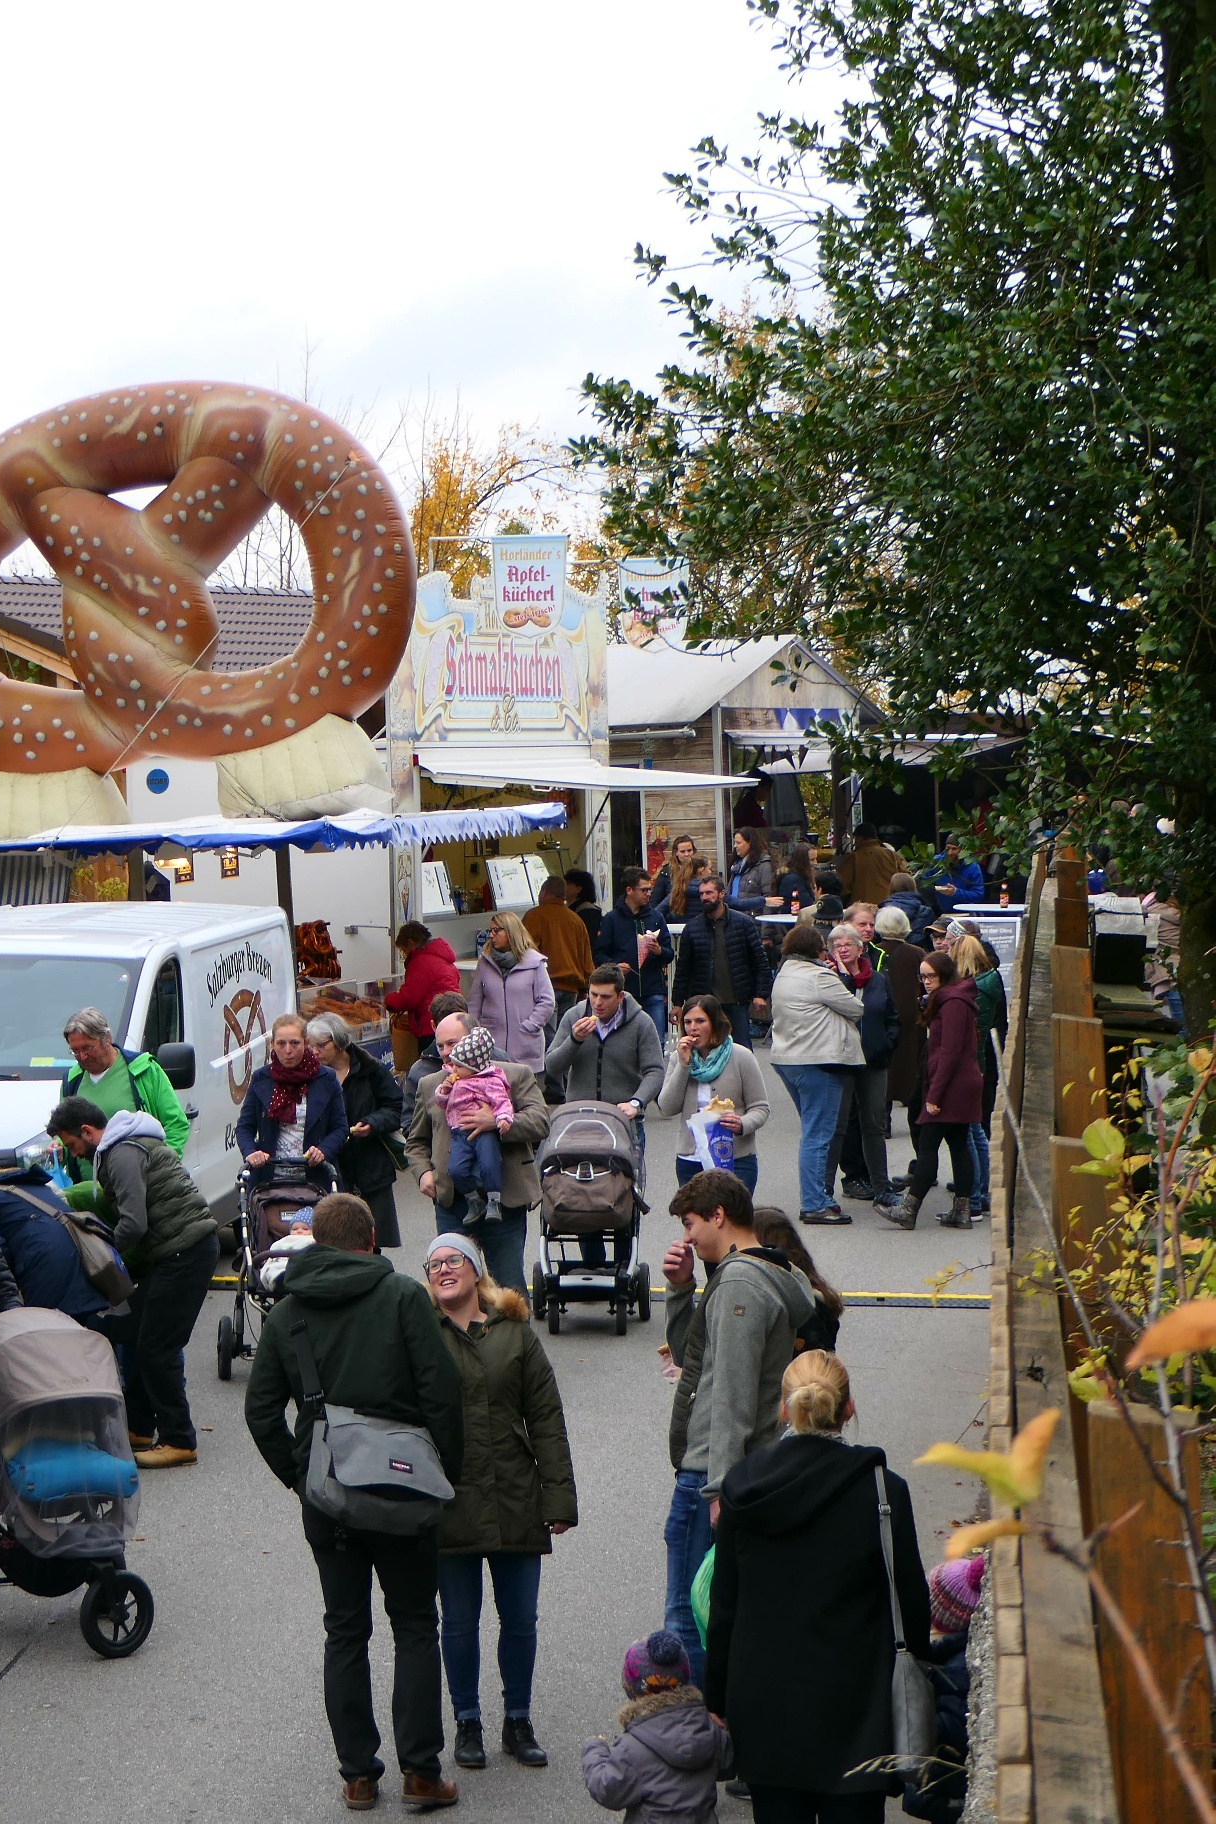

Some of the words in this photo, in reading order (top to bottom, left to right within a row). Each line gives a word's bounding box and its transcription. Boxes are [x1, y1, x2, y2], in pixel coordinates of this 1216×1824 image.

[506, 565, 551, 585] Apfel-
[444, 633, 562, 699] Schmalzkuchen
[206, 953, 245, 1009] Salzburger
[245, 941, 273, 984] Brezen
